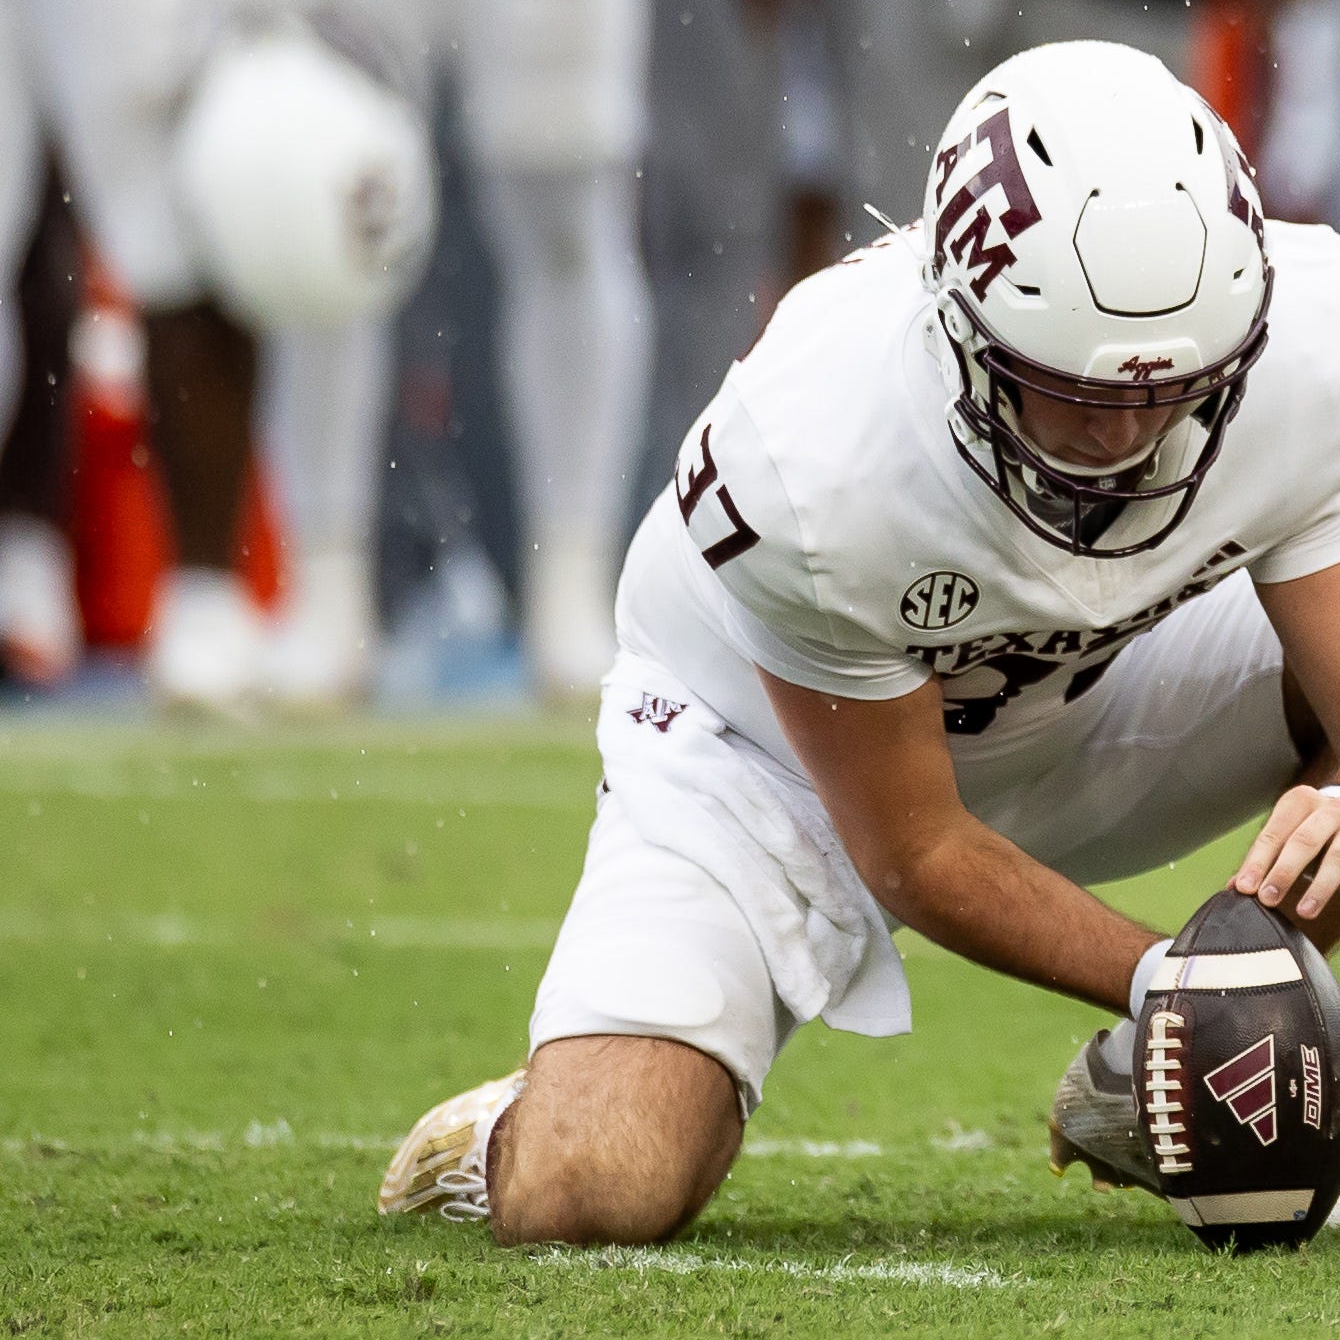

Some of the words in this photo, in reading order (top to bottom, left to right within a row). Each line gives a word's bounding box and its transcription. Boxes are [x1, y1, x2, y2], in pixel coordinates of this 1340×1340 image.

[1117, 354, 1175, 382] Aggies
[901, 571, 979, 630] SEC
[1301, 1044, 1321, 1129] DIME
